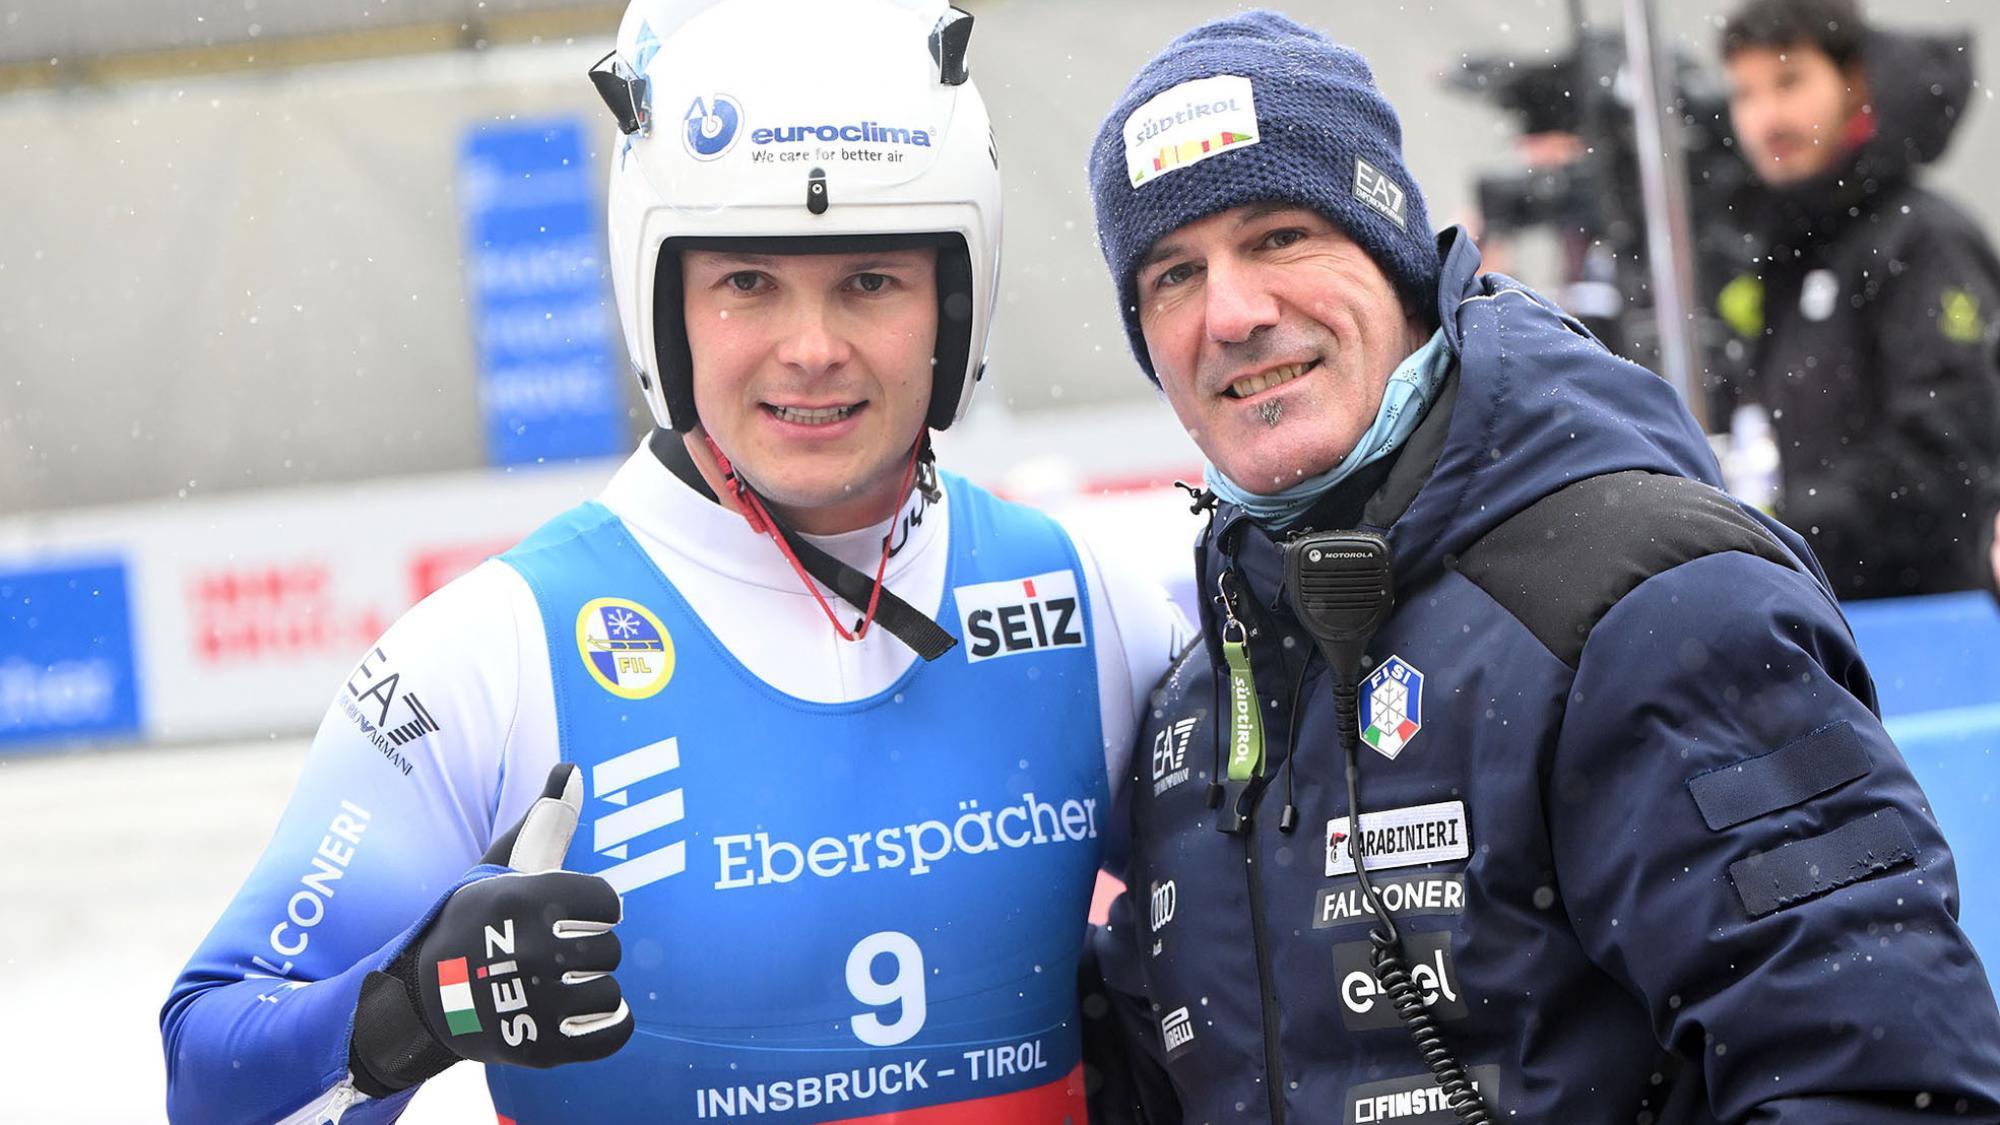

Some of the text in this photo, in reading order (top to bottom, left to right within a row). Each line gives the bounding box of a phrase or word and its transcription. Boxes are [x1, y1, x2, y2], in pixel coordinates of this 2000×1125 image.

[752, 147, 904, 163] We care for better air
[1356, 159, 1404, 213] EA7
[1324, 551, 1374, 560] MOTOROLA
[618, 656, 652, 674] FIL
[1370, 663, 1412, 690] FISI
[346, 646, 441, 747] EA7
[366, 729, 414, 777] ARMANI
[1152, 717, 1198, 781] EA7
[712, 792, 1098, 891] Eberspächer
[845, 930, 927, 1047] 9
[1341, 949, 1457, 1014] eel
[1161, 1005, 1195, 1052] PIRELLI
[696, 1059, 929, 1119] INNSBRUCK
[963, 1039, 1048, 1081] TIROL
